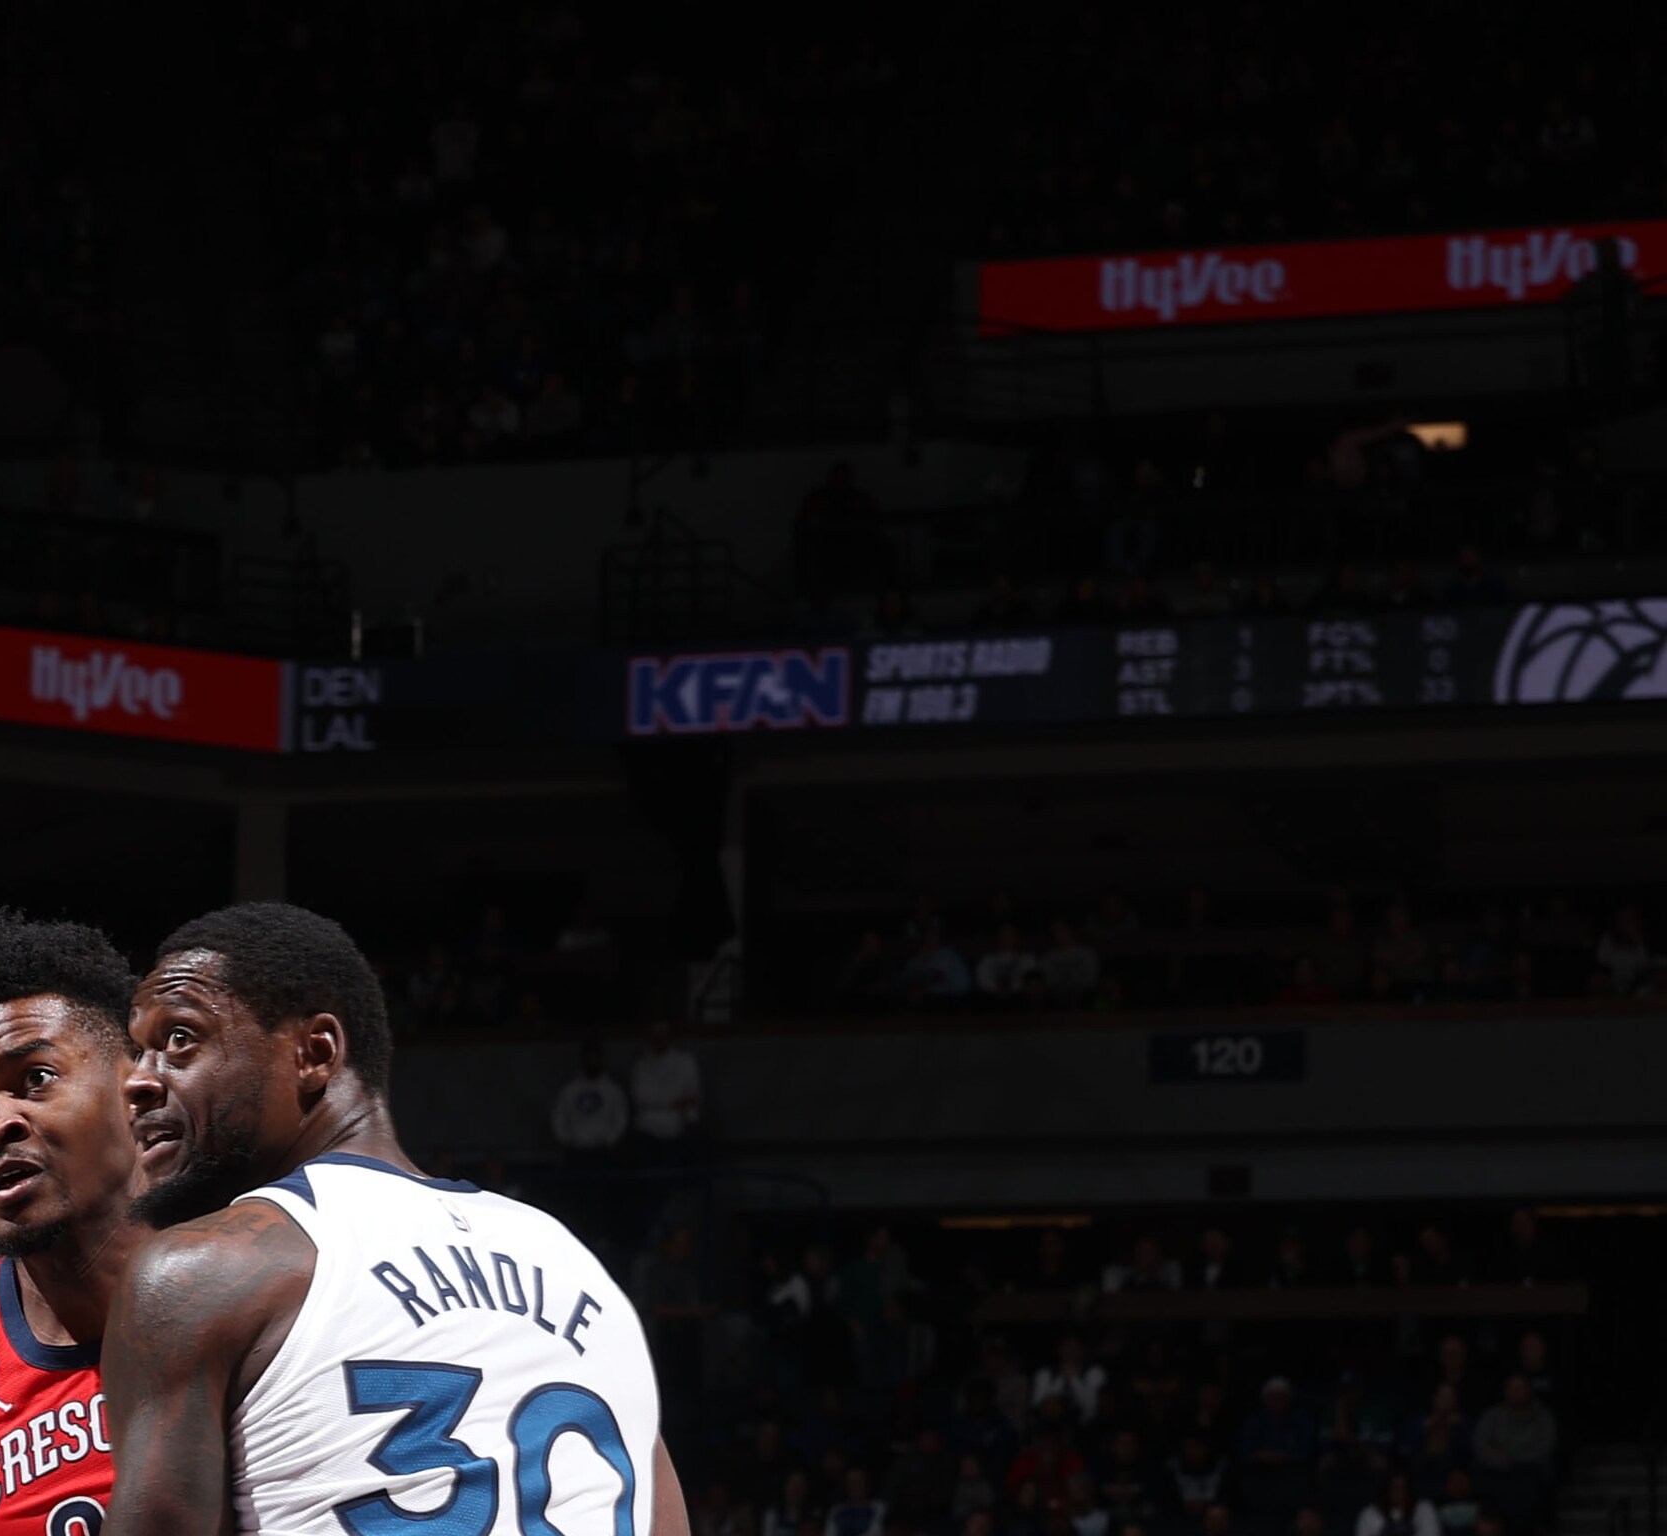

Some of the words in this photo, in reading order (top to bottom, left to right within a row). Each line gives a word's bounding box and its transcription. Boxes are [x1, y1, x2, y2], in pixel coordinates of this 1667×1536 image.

[866, 640, 966, 682] SPORTS
[1117, 628, 1178, 656] REB
[303, 666, 380, 706] DEN
[1118, 656, 1177, 685] AST
[628, 647, 851, 736] KFAN
[863, 686, 904, 725] FM
[1118, 686, 1174, 716] STL
[301, 712, 375, 753] LAL
[1192, 1037, 1264, 1075] 120
[372, 1245, 601, 1356] RANDLE
